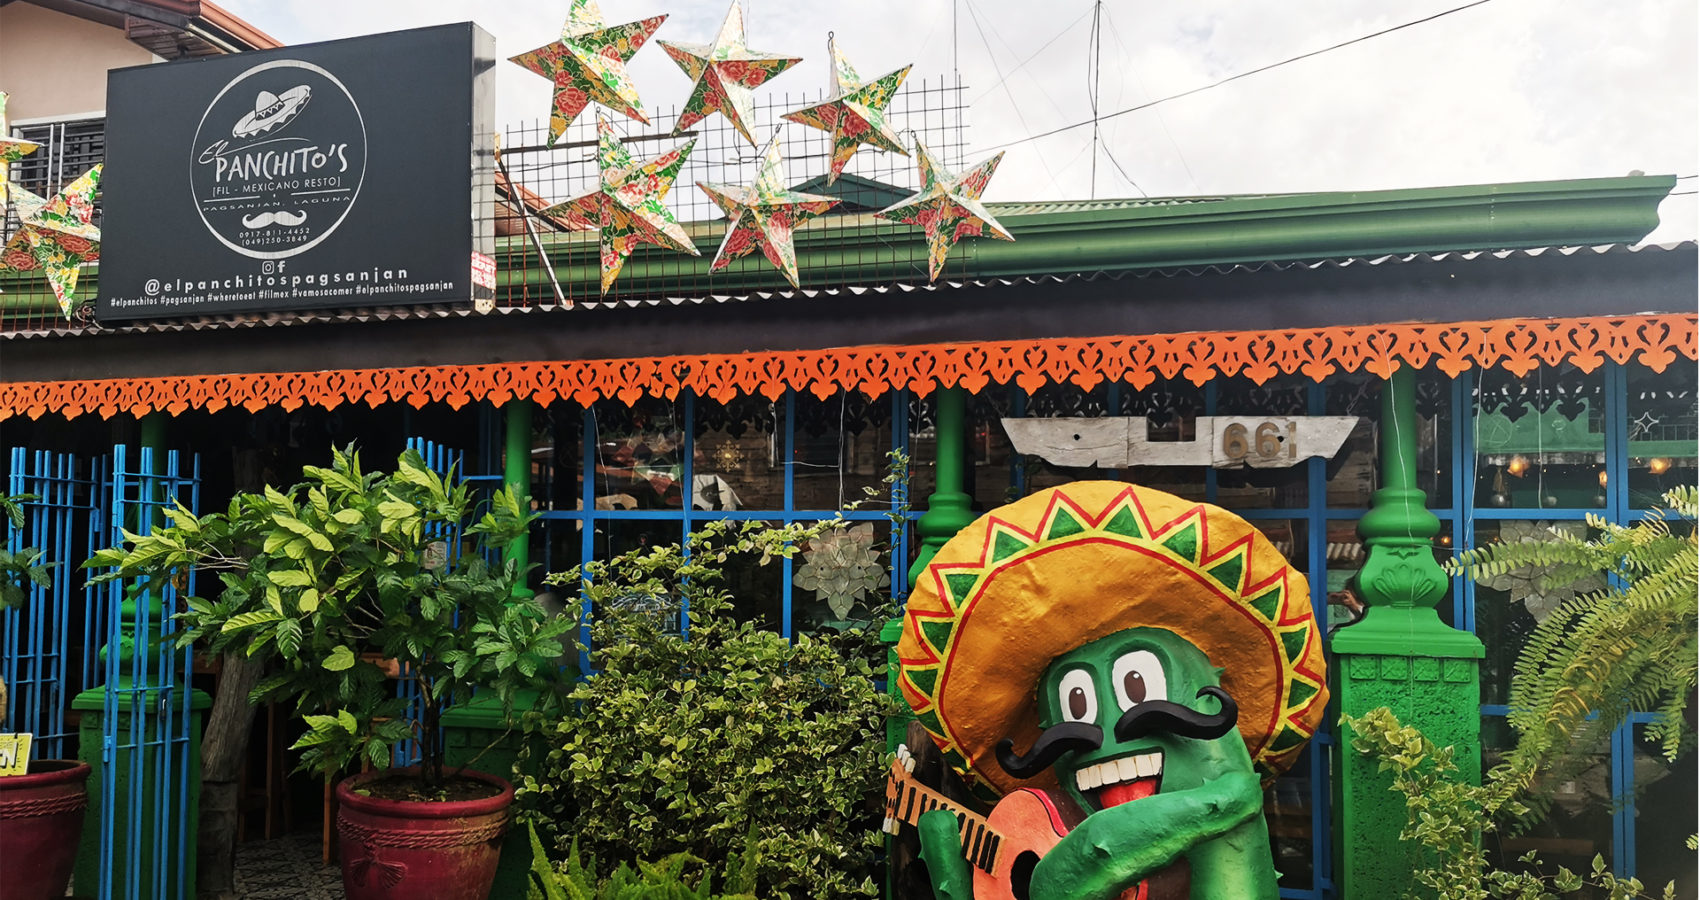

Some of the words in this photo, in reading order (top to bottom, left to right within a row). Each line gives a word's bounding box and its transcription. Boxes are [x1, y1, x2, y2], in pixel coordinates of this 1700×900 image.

[199, 140, 229, 165] El
[215, 143, 348, 183] PANCHITO'S
[242, 180, 300, 193] MEXICANO
[294, 196, 351, 205] LAGUNA
[239, 227, 310, 239] 0917-811-4452
[241, 235, 307, 248] (049)250-3849
[110, 295, 157, 308] #elpanchitos
[160, 294, 205, 307] #pagsanjan
[207, 291, 256, 303] #wheretoeat
[258, 289, 289, 300] #filmex
[292, 287, 353, 298] #vamosacomer
[355, 280, 454, 297] #elpanchitospagsanjan
[144, 267, 408, 296] @elpanchitospagsanjan
[1223, 421, 1297, 459] 661
